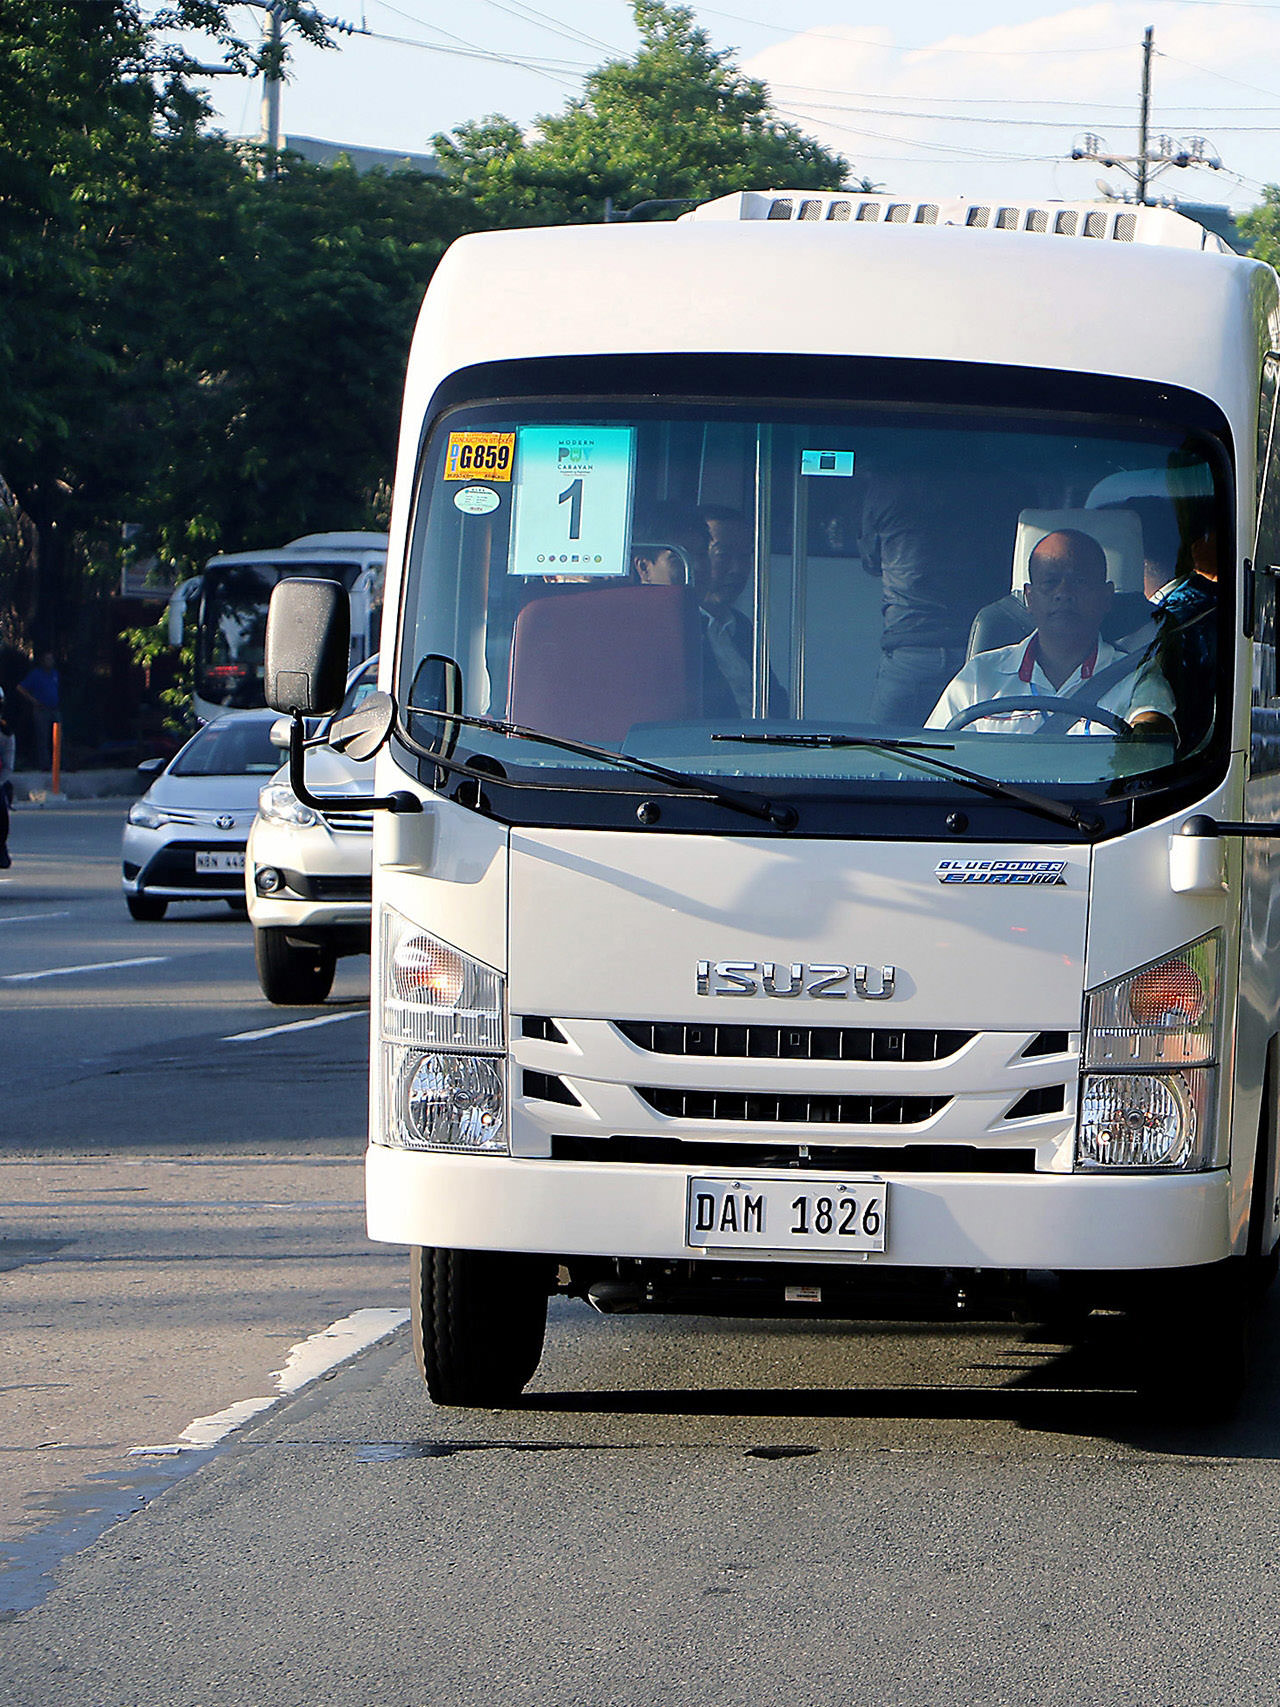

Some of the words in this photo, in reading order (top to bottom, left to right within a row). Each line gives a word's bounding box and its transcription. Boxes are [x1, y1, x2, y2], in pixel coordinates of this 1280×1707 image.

[460, 444, 510, 470] G859
[558, 478, 583, 539] 1
[695, 960, 896, 1000] ISUZU
[695, 1192, 763, 1234] DAM
[791, 1196, 880, 1236] 1826
